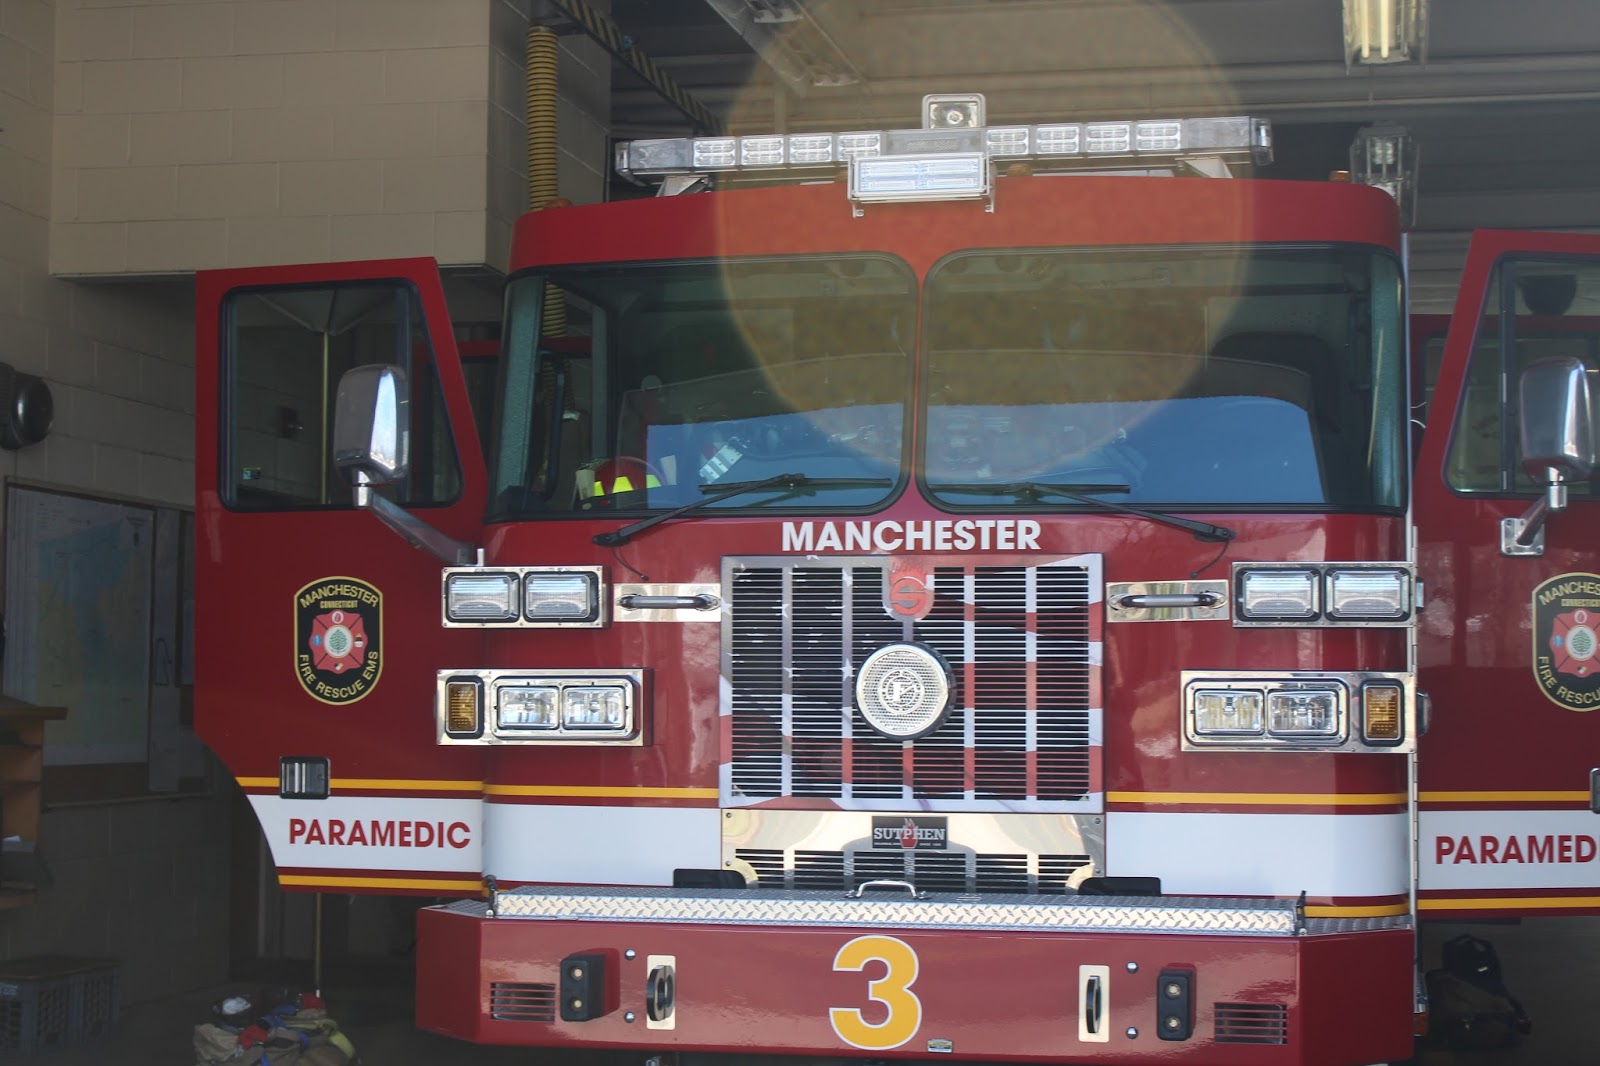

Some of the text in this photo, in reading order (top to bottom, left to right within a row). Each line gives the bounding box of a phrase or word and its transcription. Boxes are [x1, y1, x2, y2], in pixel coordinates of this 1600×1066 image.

[781, 520, 1041, 551] MANCHESTER
[299, 584, 379, 608] MANCHESTER
[299, 651, 379, 699] FIRE RESCUE EMS
[1538, 656, 1558, 688] FIRE
[289, 818, 471, 849] PARAMEDIC
[873, 827, 946, 840] SUTPHEN
[1435, 834, 1600, 865] PARAMED
[829, 935, 922, 1050] 3
